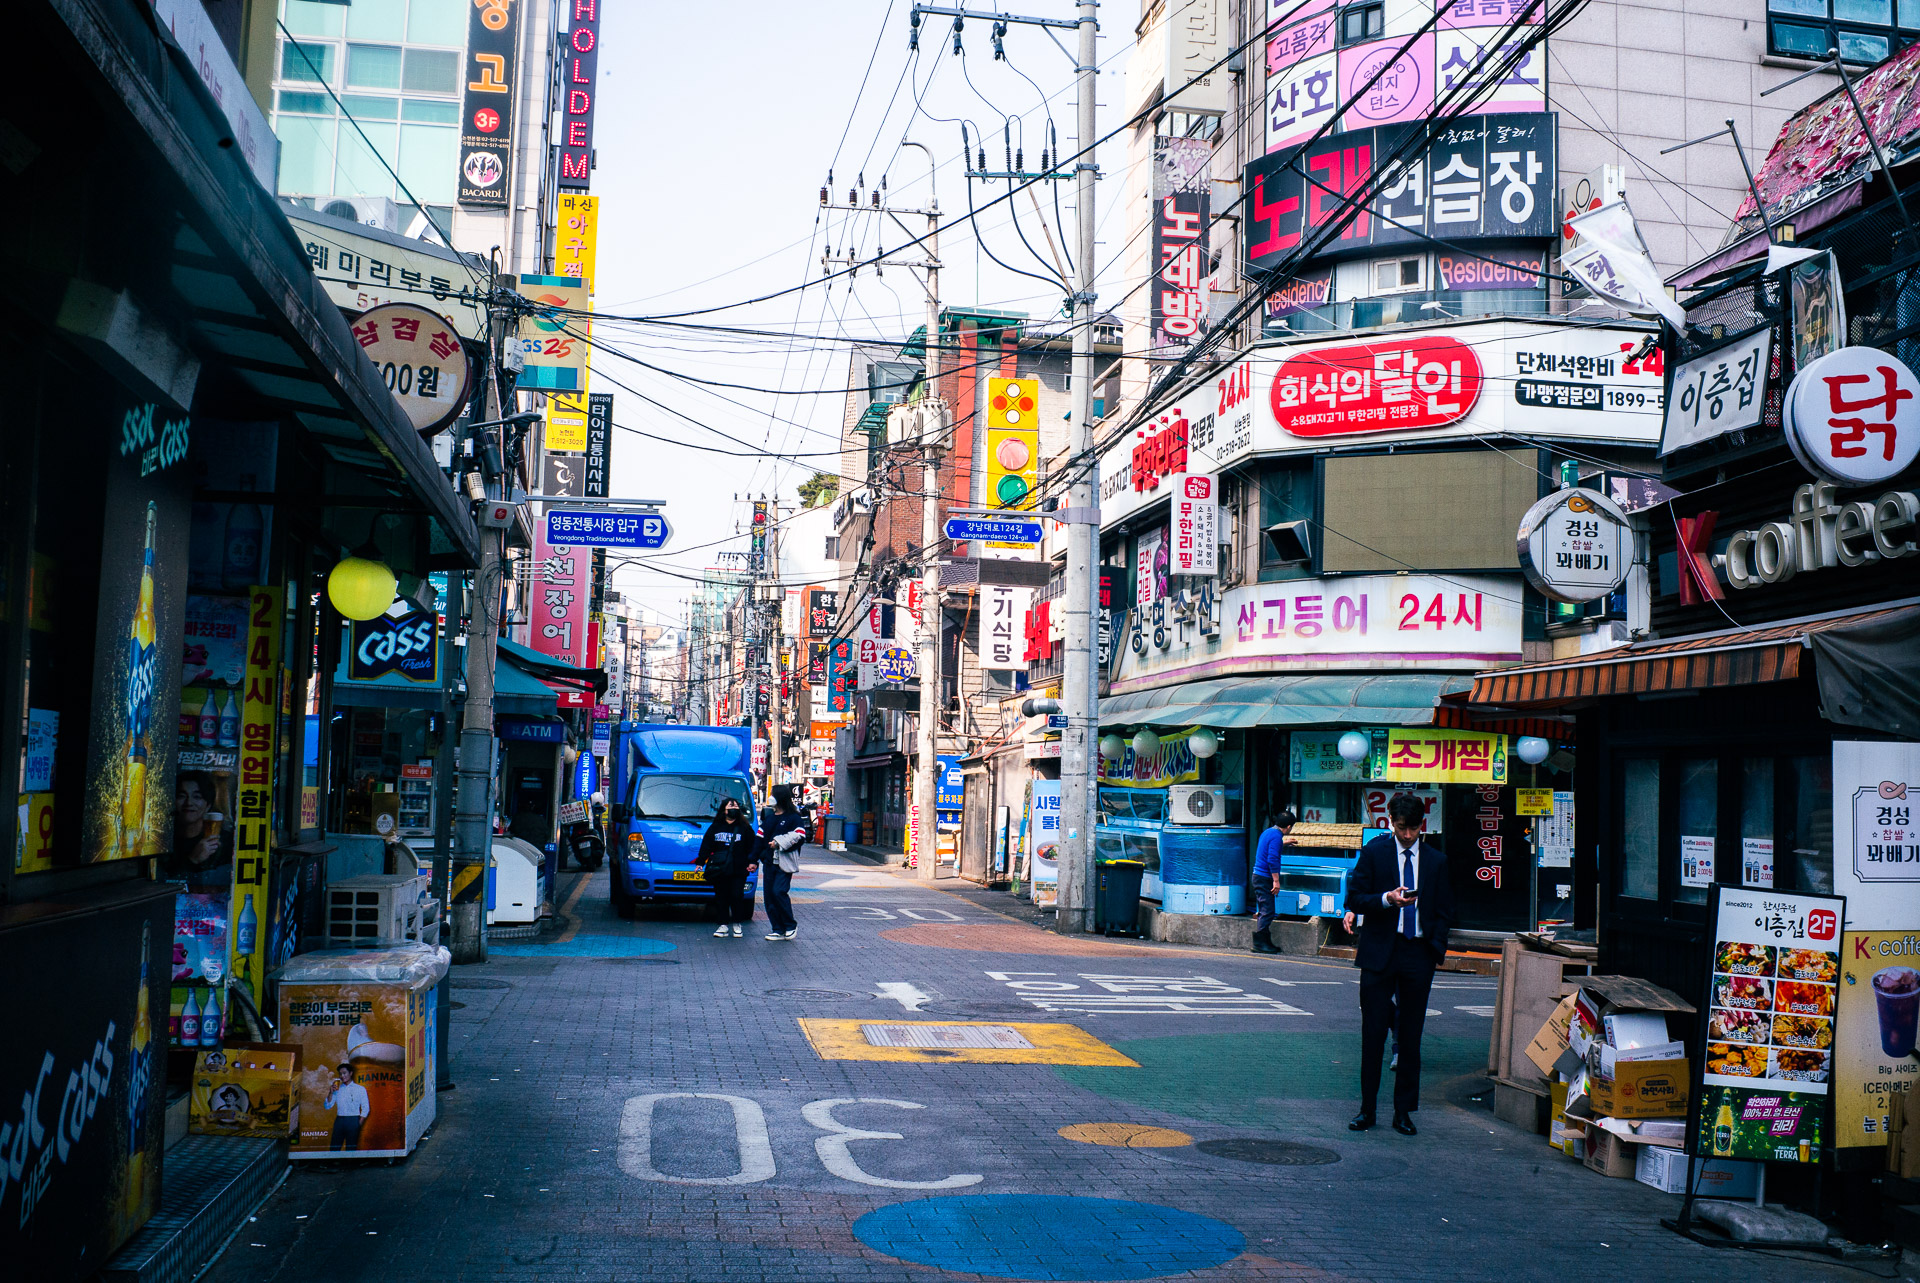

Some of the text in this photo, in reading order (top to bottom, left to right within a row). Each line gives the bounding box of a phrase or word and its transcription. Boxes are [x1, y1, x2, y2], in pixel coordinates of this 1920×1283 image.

[1274, 19, 1327, 61] 고품격
[1441, 40, 1540, 91] 산호
[562, 0, 596, 179] HOLDEM
[1270, 69, 1335, 132] 산호
[1369, 94, 1401, 112] 던스
[475, 111, 499, 129] 3F
[563, 197, 594, 213] 마산
[1161, 195, 1202, 338] 노래방
[351, 316, 461, 361] 삼겹살
[1515, 351, 1615, 380] 단체석완비
[1218, 360, 1251, 418] 24시
[1279, 349, 1462, 416] 회식의 달인
[1680, 347, 1761, 428] 이층집
[1519, 382, 1601, 406] 가맹점문의
[1347, 406, 1387, 423] 무한리필
[1389, 404, 1419, 419] 전문점
[1821, 364, 1914, 462] 닭
[1190, 411, 1215, 453] 전문점
[1187, 484, 1206, 498] 달인
[550, 515, 639, 534] 영동전통시장 입구
[966, 521, 1024, 534] 강남대로124길
[1564, 519, 1600, 539] 경성
[553, 534, 636, 545] Yeongdong Traditional Market
[960, 532, 1029, 542] Gangnam-daero 124-gil
[1178, 502, 1194, 569] 무한리필
[1571, 539, 1594, 551] 찹쌀
[1131, 580, 1221, 655] 광명수산
[1236, 592, 1483, 643] 산고등어 24시
[244, 592, 274, 706] 24시
[400, 656, 433, 670] Fresh
[879, 658, 914, 677] 주차장
[521, 724, 552, 738] ATM
[1389, 739, 1491, 772] 조개찜
[581, 752, 590, 793] COIN TENNIS
[236, 722, 272, 887] 영업합니다
[1875, 806, 1910, 826] 경성
[1882, 829, 1905, 841] 찹쌀
[1725, 901, 1753, 909] since2012
[1754, 912, 1835, 939] 이층집 2F
[288, 1000, 373, 1014] 한없이 부드러운
[337, 1014, 362, 1026] 만남
[357, 1071, 403, 1084] HANMAC
[1878, 1063, 1919, 1075] Big 사이즈
[300, 1130, 329, 1138] HANMAC
[1771, 1119, 1795, 1133] 테라
[1774, 1149, 1799, 1161] TERRA
